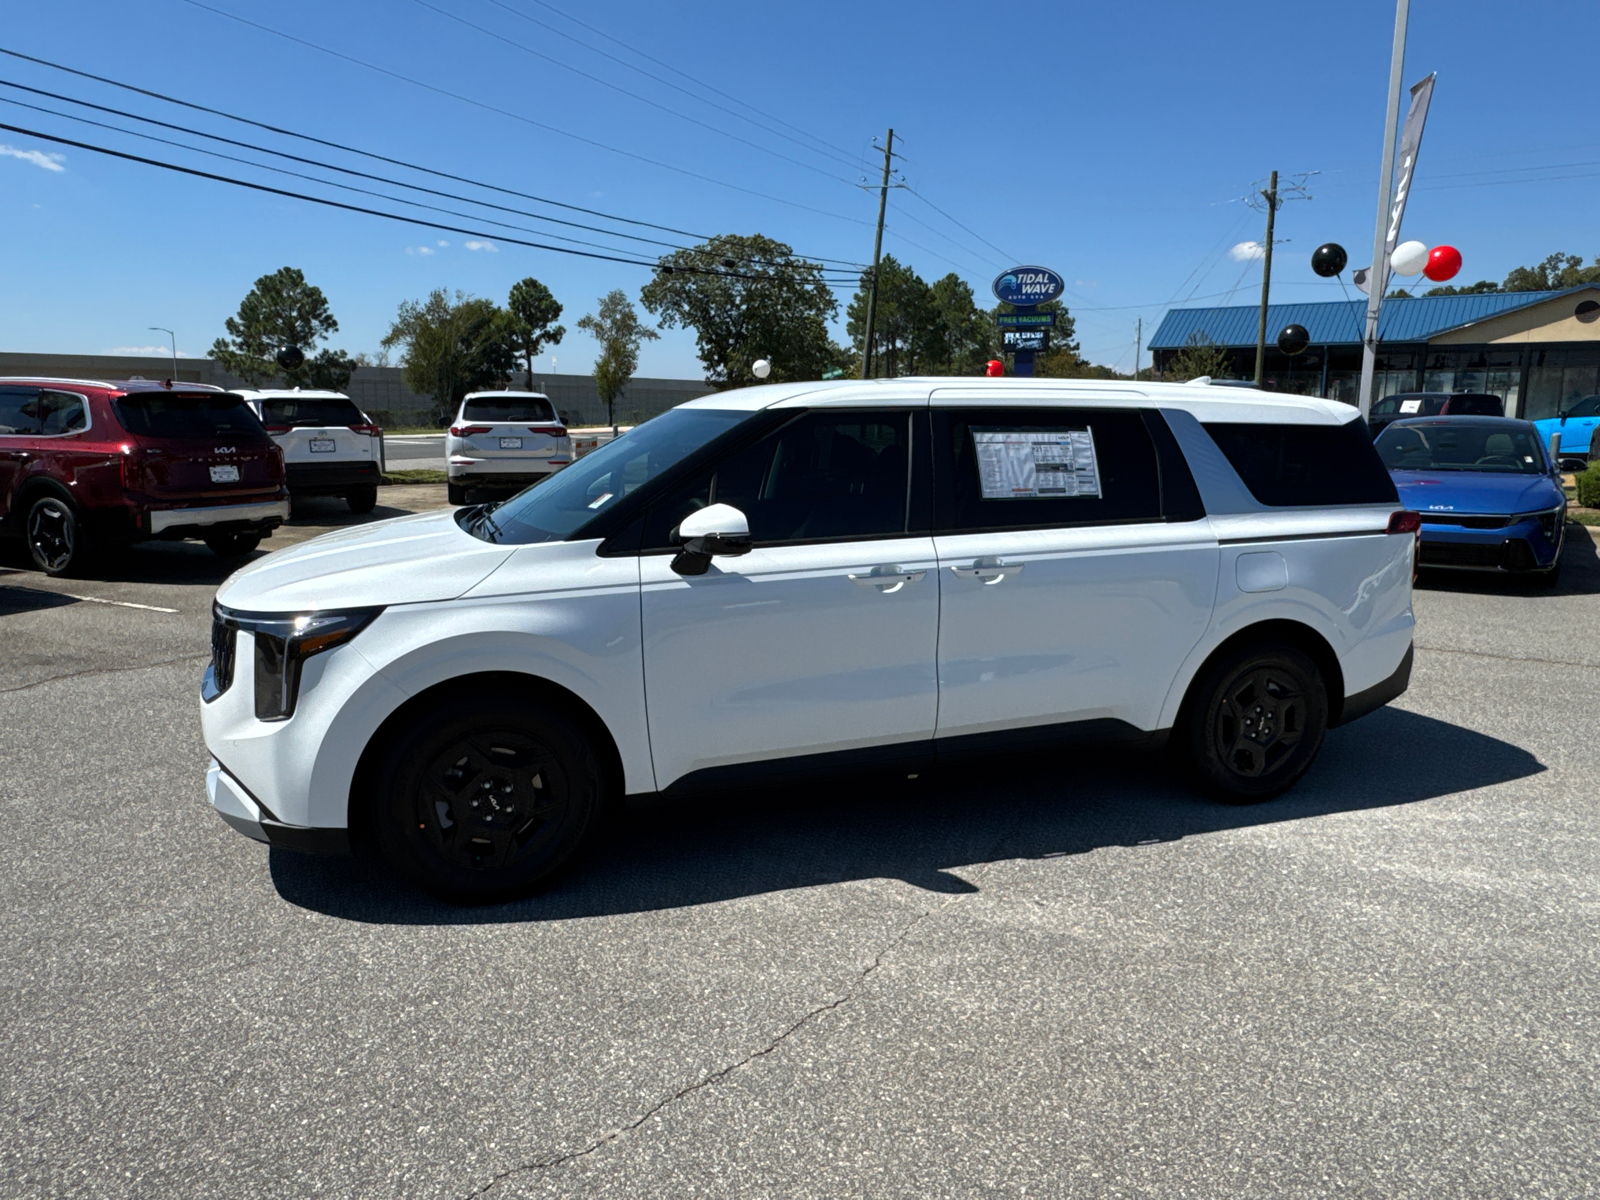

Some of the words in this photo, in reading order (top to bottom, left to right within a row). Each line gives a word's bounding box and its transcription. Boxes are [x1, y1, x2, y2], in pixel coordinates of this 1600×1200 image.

[1016, 273, 1049, 284] TIDAL
[1021, 283, 1056, 294] WAVE
[999, 316, 1017, 324] FREE
[1018, 315, 1051, 324] VACUUMS
[214, 446, 237, 454] KIA
